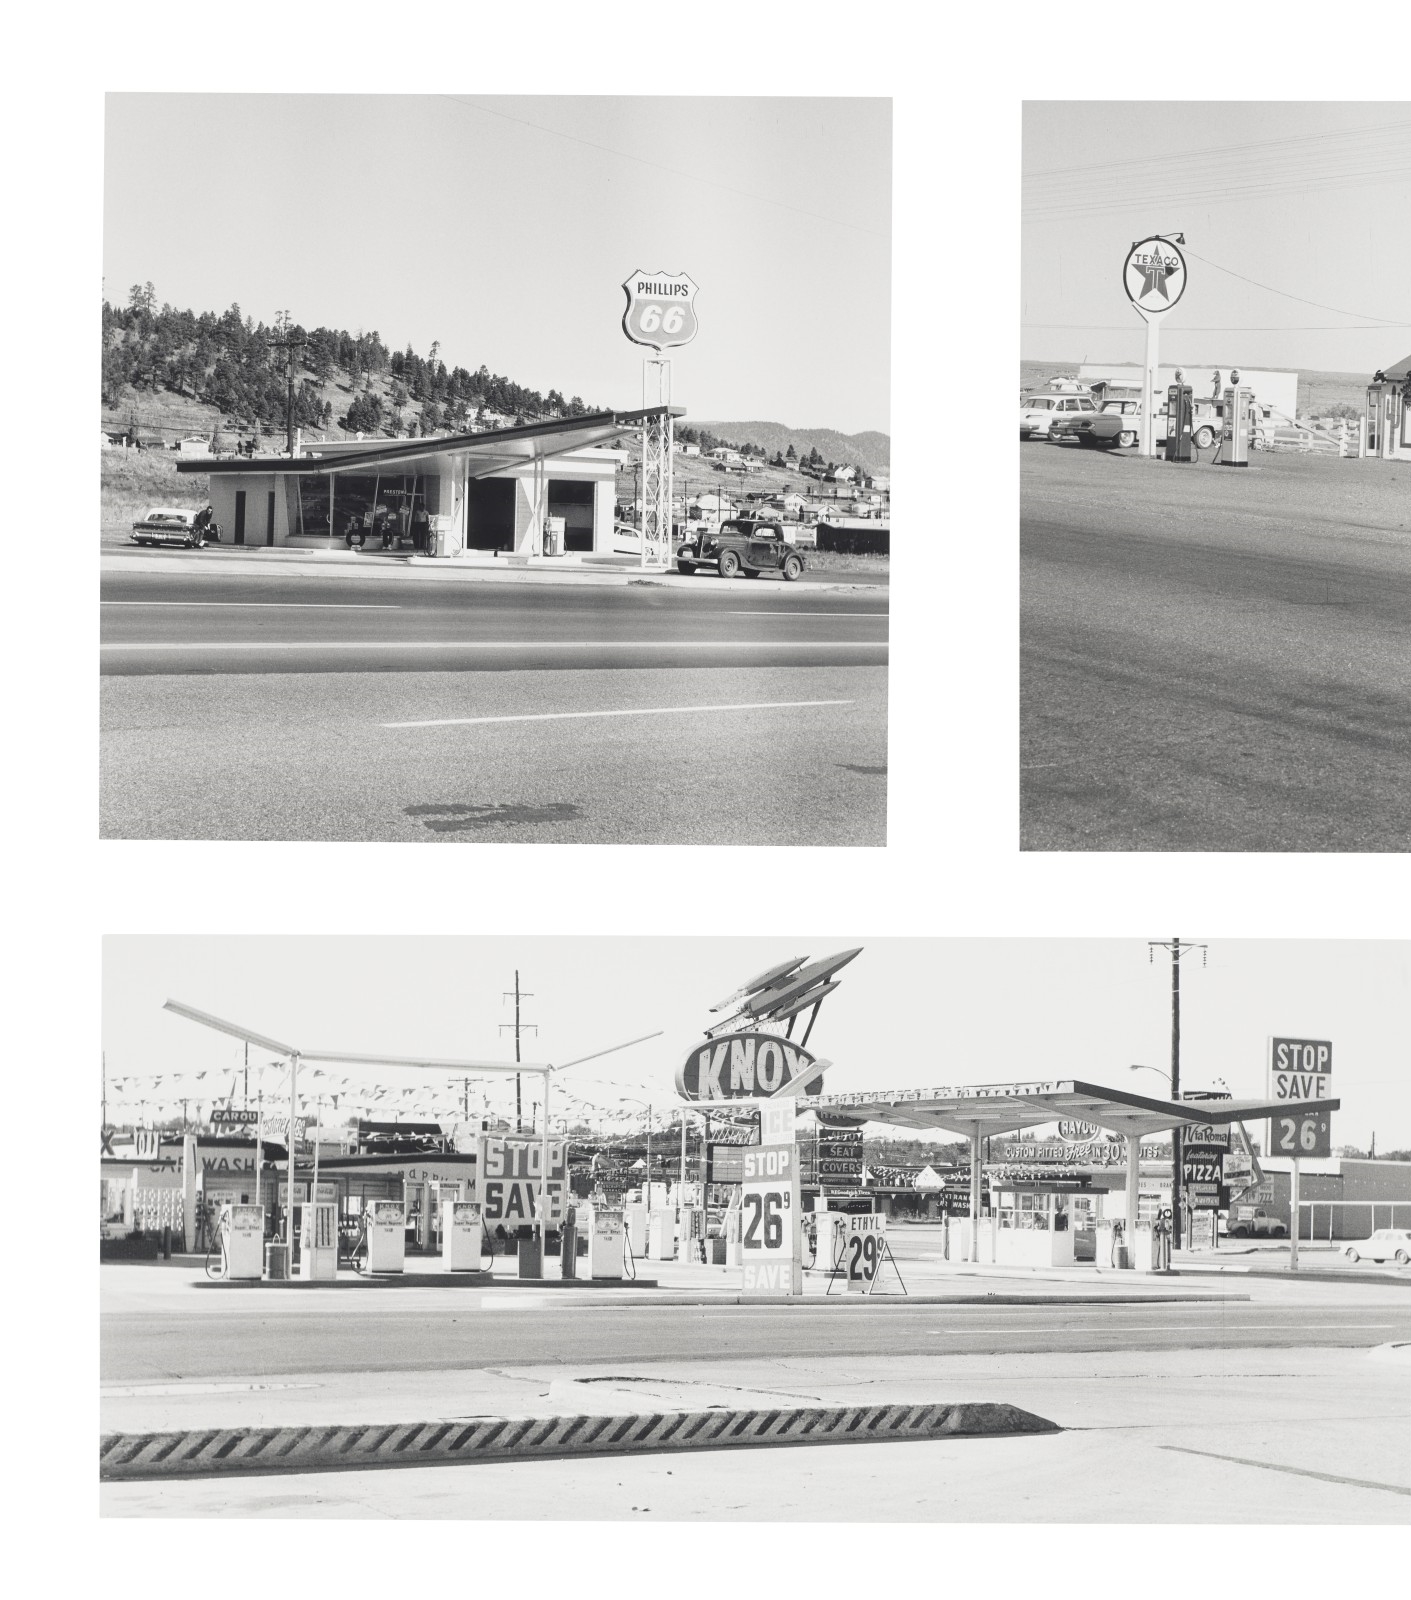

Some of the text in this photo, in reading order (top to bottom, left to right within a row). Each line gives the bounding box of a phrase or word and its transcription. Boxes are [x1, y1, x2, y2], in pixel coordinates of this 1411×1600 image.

[1134, 253, 1179, 267] TEXACO
[637, 281, 689, 297] PHILLIPS
[639, 304, 686, 334] 66
[1276, 1043, 1328, 1072] STOP
[697, 1037, 811, 1102] KNOX
[1276, 1073, 1326, 1100] SAVE
[762, 1109, 794, 1134] ICE
[1186, 1125, 1228, 1143] Via Roma
[485, 1140, 564, 1177] STOP
[829, 1147, 855, 1157] SEAT
[1005, 1143, 1121, 1161] CUSTOM FITTED Free IN 30
[202, 1157, 256, 1172] WASH
[743, 1149, 790, 1178] STOP
[822, 1162, 862, 1174] COVERS
[1183, 1163, 1222, 1182] PIZZA
[851, 1216, 880, 1231] ETHYL
[742, 1263, 791, 1291] SAVE
